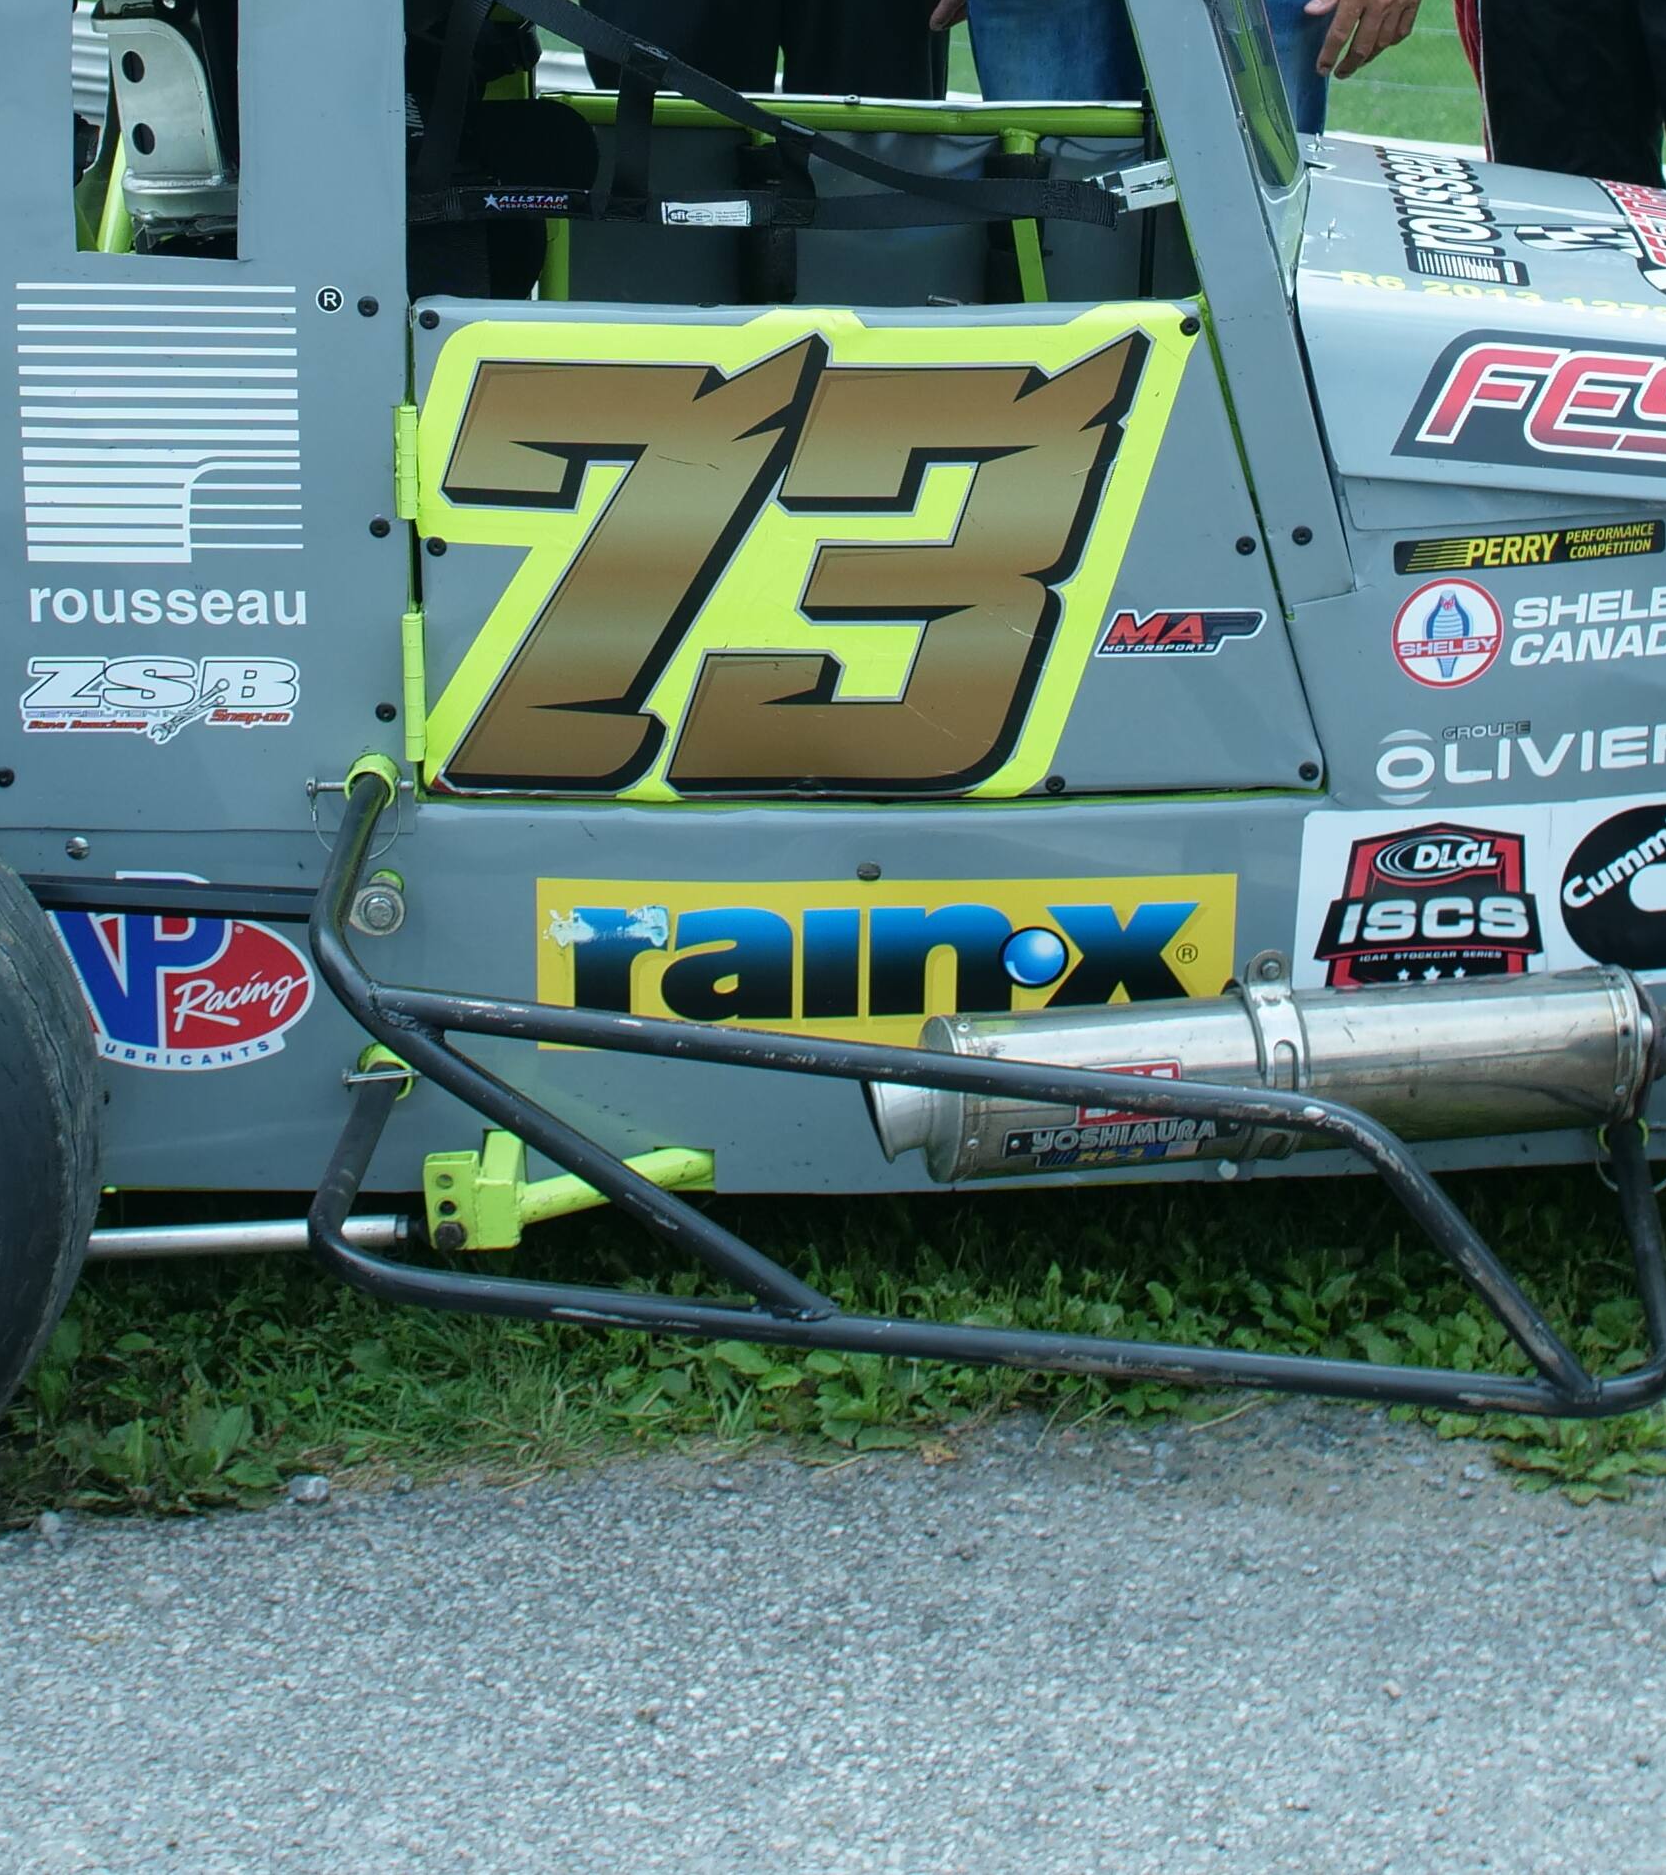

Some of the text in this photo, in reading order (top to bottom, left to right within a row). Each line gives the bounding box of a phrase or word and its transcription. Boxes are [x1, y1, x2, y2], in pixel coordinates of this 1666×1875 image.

[499, 194, 564, 204] ALLSTAR
[1465, 522, 1655, 568] PERRY PERFORMANCE
[1569, 538, 1652, 560] COMPÉTITION
[437, 327, 1154, 796] 73
[30, 586, 307, 626] rousseau
[1105, 610, 1263, 643] MAP
[1101, 640, 1217, 654] MOTORSPORTS
[1398, 637, 1496, 657] SHELBY
[24, 660, 297, 709] ZSB
[209, 709, 290, 724] Snap-on
[1441, 720, 1532, 740] GROUPE
[1413, 841, 1501, 870] DLGL
[1337, 897, 1530, 945] ISCS
[1462, 949, 1503, 959] SERIES
[173, 970, 309, 1033] Racing
[104, 1039, 271, 1066] UBRICANTS
[1031, 1119, 1217, 1153] YOSHIMURA
